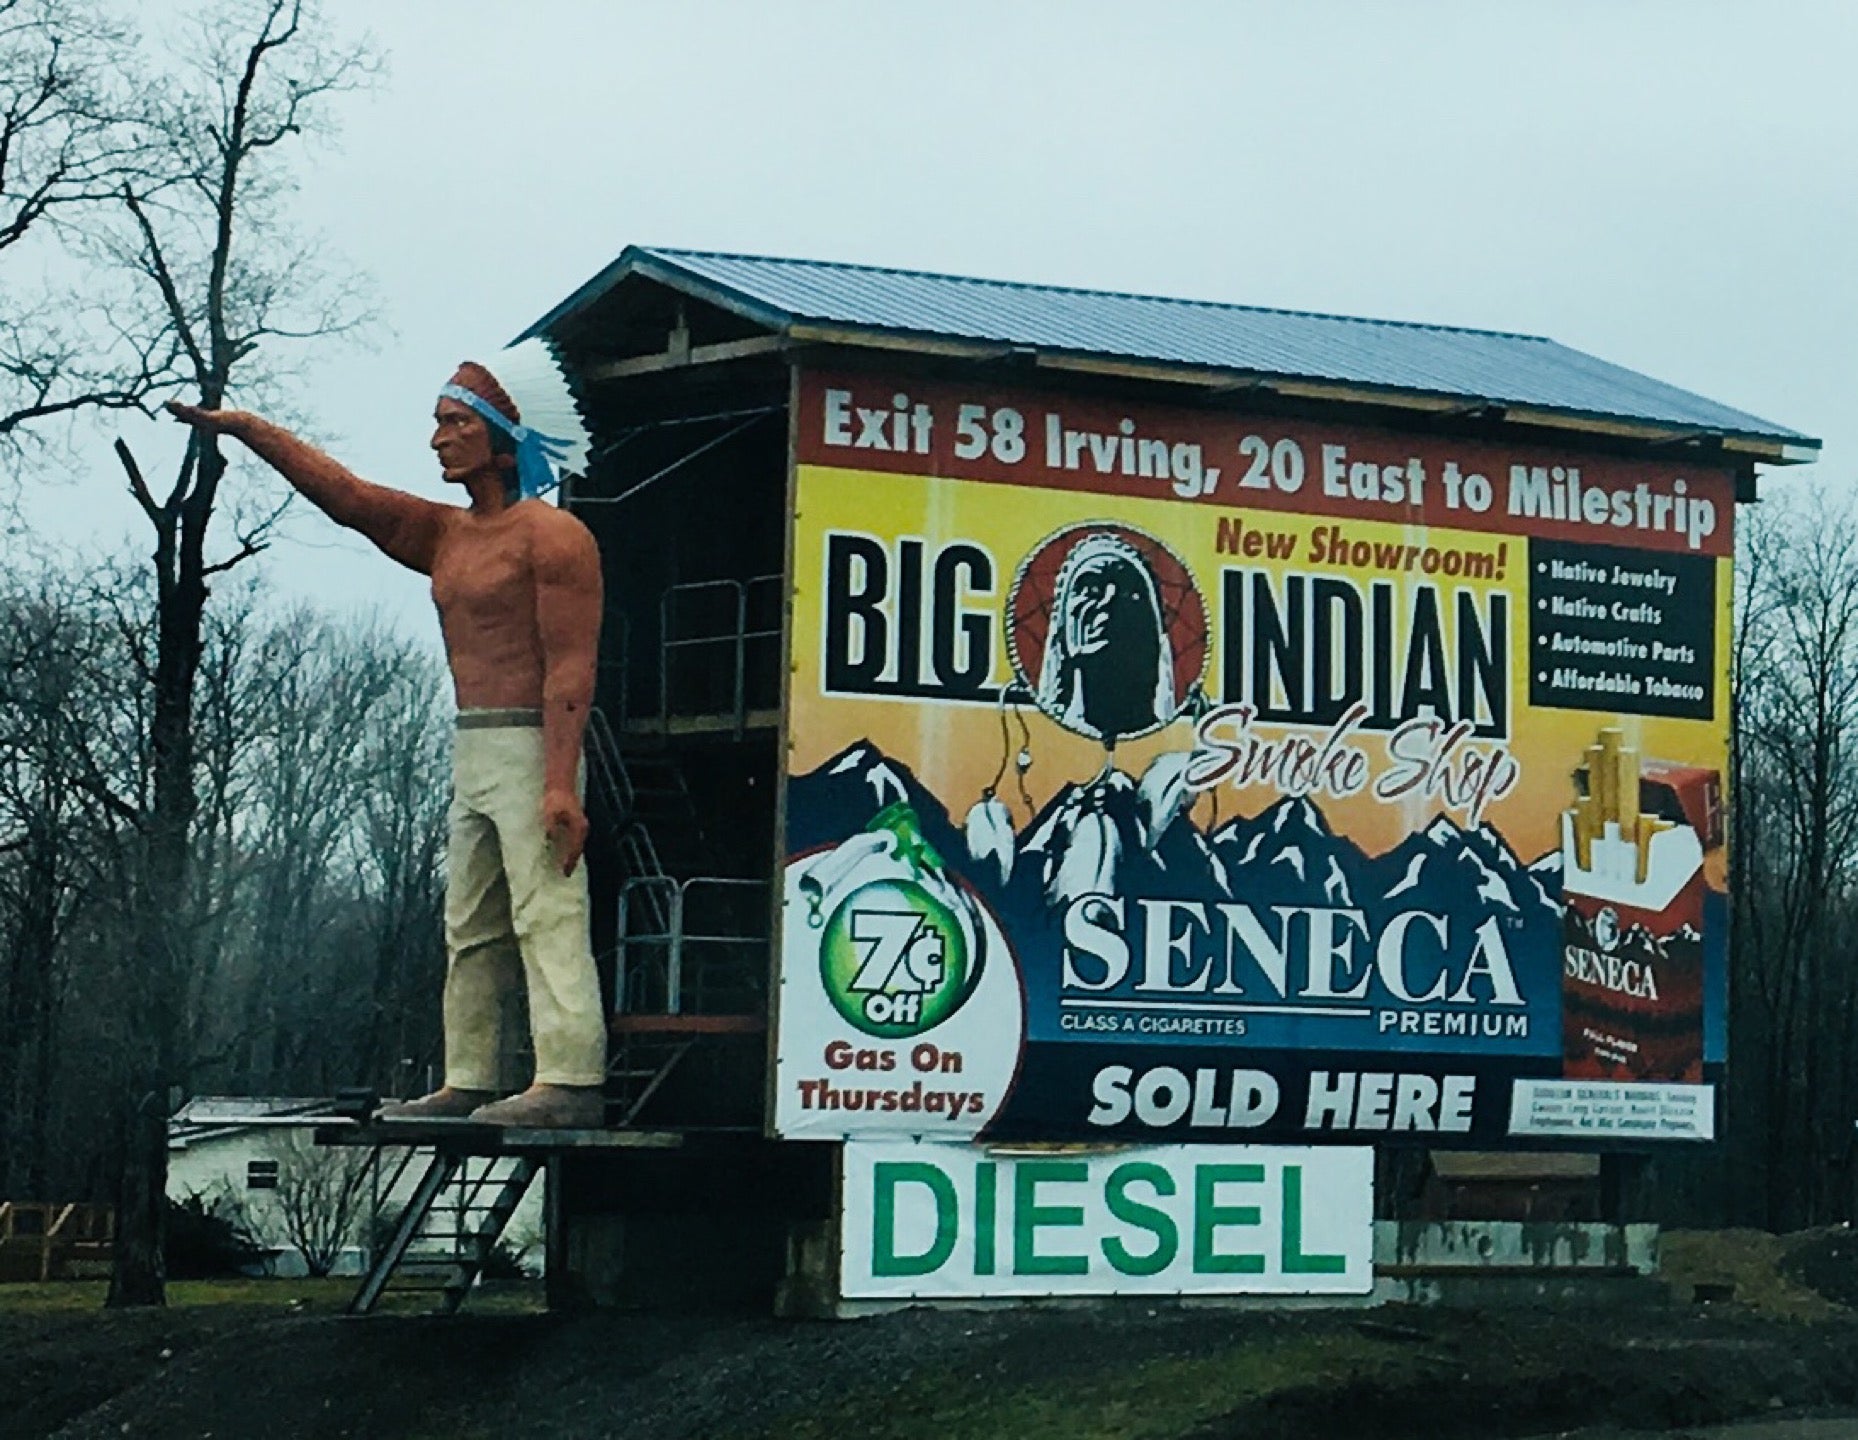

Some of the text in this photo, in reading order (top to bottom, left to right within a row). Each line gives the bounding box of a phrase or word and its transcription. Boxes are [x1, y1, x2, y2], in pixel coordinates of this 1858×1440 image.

[823, 389, 1717, 549] Exit 58 Irving, 20 East to Milestrip
[1215, 517, 1508, 581] New Showroom!
[1551, 559, 1677, 596] Native Jewelry
[1551, 595, 1662, 625] Native Crafts
[823, 532, 1508, 738] BIG INDIAN
[1551, 631, 1696, 664] Automotive Parts
[1551, 668, 1704, 700] Affordable Tobacco
[1184, 704, 1518, 827] Smoke Shop
[1062, 893, 1527, 1006] SENECA
[1565, 944, 1659, 1001] SENECA
[862, 992, 922, 1025] Off
[1060, 1014, 1245, 1035] CLASS A CIGARETTES
[1380, 1010, 1528, 1037] PREMIUM
[824, 1040, 962, 1073] Gas On
[797, 1078, 984, 1120] Thursdays
[1087, 1065, 1476, 1132] SOLD HERE
[871, 1162, 1346, 1277] DIESEL
